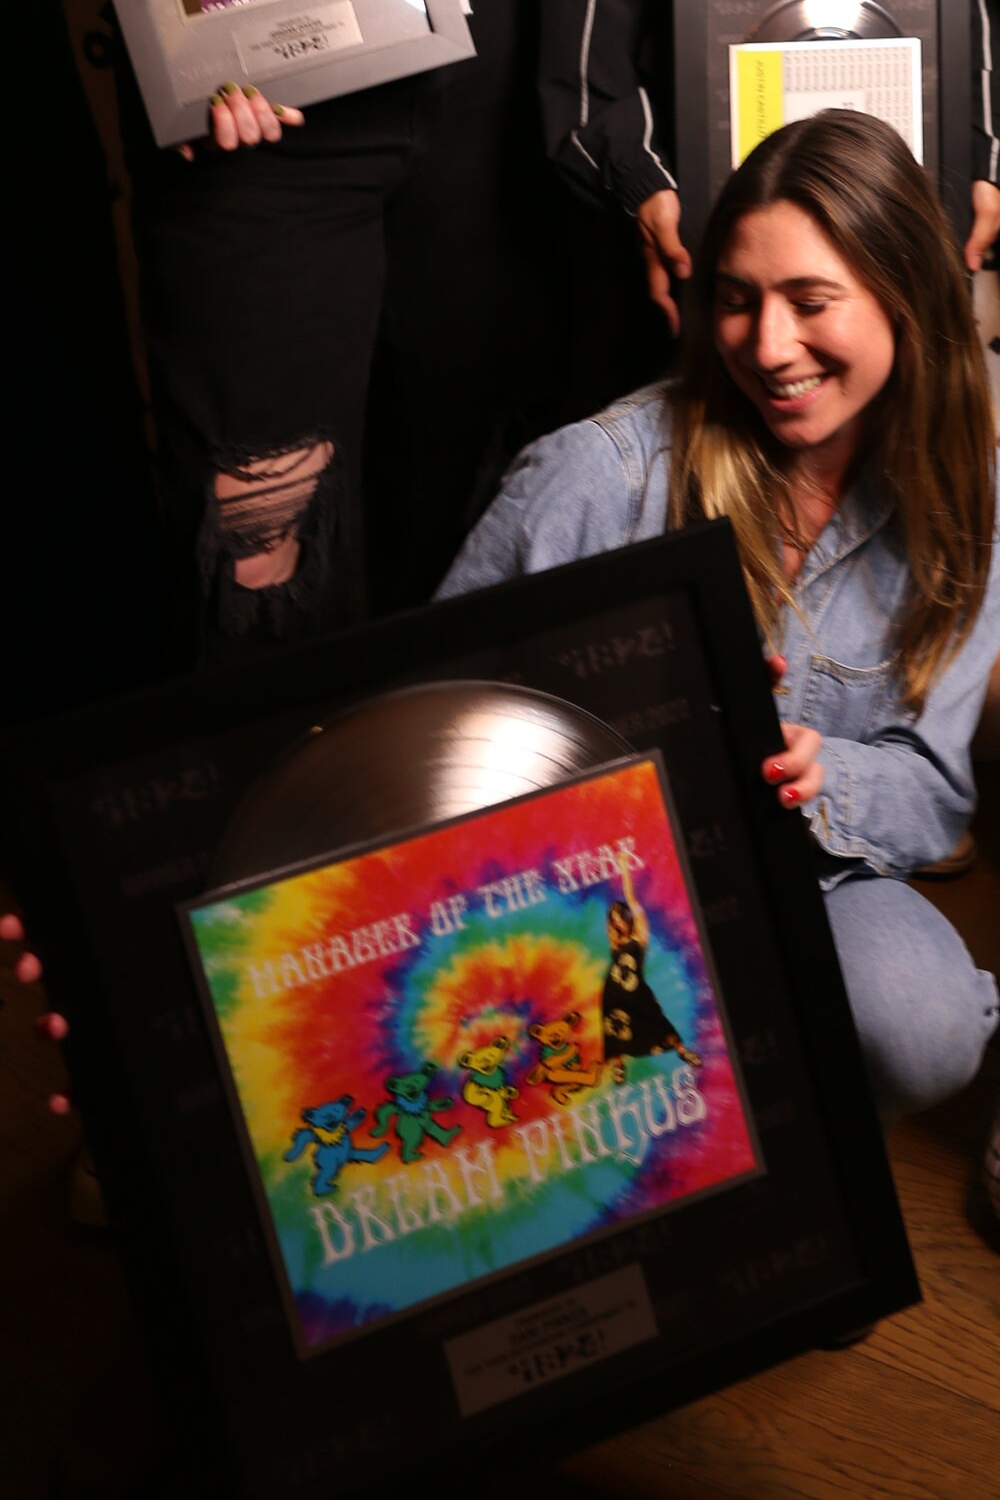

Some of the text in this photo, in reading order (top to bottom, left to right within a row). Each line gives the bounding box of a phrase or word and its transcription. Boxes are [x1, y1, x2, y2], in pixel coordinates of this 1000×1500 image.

[247, 911, 421, 998] MANAGER
[429, 895, 469, 938] OF
[477, 868, 546, 919] THE
[552, 836, 645, 895] YEAR
